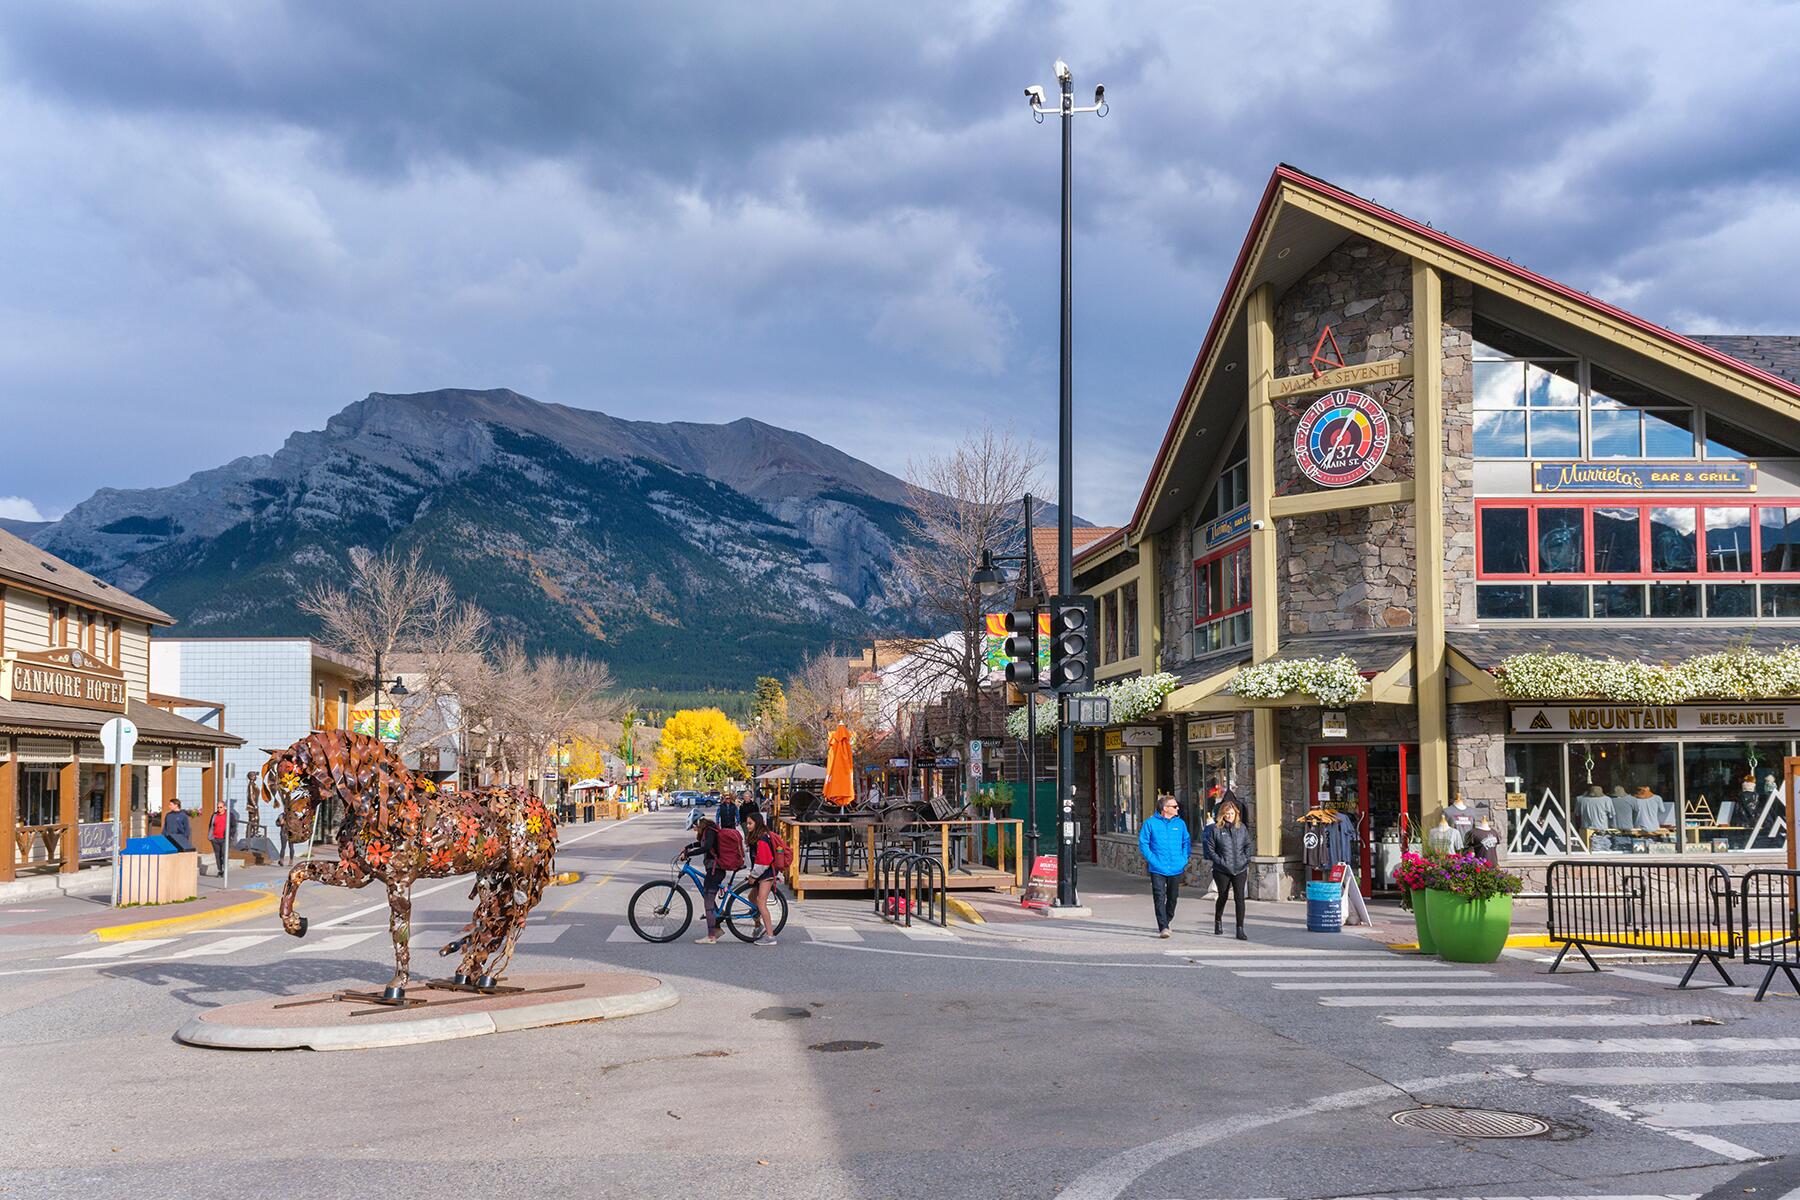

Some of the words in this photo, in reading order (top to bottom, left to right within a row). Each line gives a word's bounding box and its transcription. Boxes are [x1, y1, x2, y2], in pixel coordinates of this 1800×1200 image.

[1280, 376, 1319, 393] MAIN
[1323, 375, 1332, 386] &
[1336, 362, 1401, 383] SEVENTH
[1336, 392, 1344, 405] 0
[1356, 395, 1371, 409] 10
[1370, 410, 1386, 425] 20
[1373, 435, 1388, 448] 30
[1546, 463, 1644, 491] Murrieta's
[1651, 472, 1681, 481] BAR
[1684, 473, 1695, 481] &
[1699, 473, 1741, 482] GRILL
[14, 666, 81, 699] CANMORE
[86, 678, 125, 704] HOTEL
[1568, 708, 1678, 730] MOUNTAIN
[1699, 711, 1785, 725] MERCANTILE
[1328, 760, 1348, 772] 104
